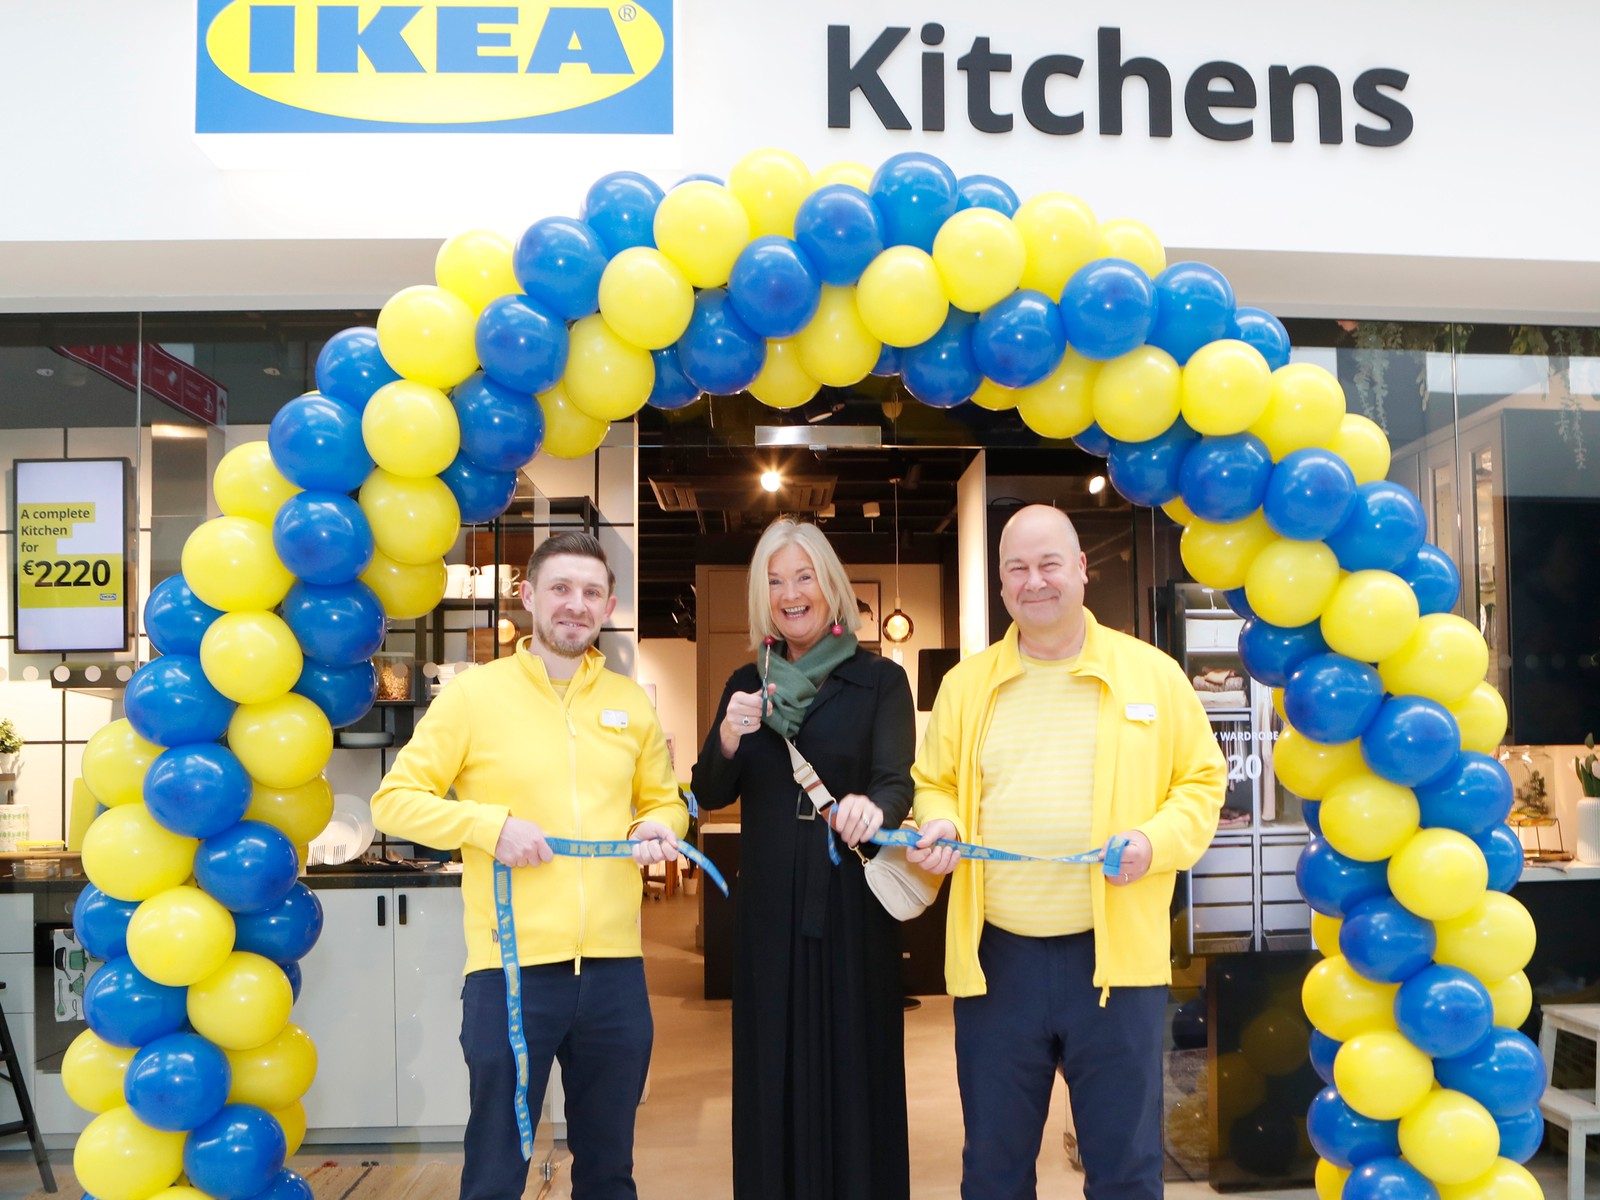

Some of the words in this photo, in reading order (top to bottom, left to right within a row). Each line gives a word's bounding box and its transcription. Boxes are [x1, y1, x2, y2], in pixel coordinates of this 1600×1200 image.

[249, 5, 635, 74] IKEA
[827, 22, 1414, 147] Kitchens
[21, 509, 30, 519] A
[33, 508, 90, 521] complete
[21, 525, 68, 536] Kitchen
[21, 542, 39, 552] for
[23, 559, 111, 587] €2220
[1220, 731, 1279, 741] WARDROBE
[570, 843, 632, 855] IKEA
